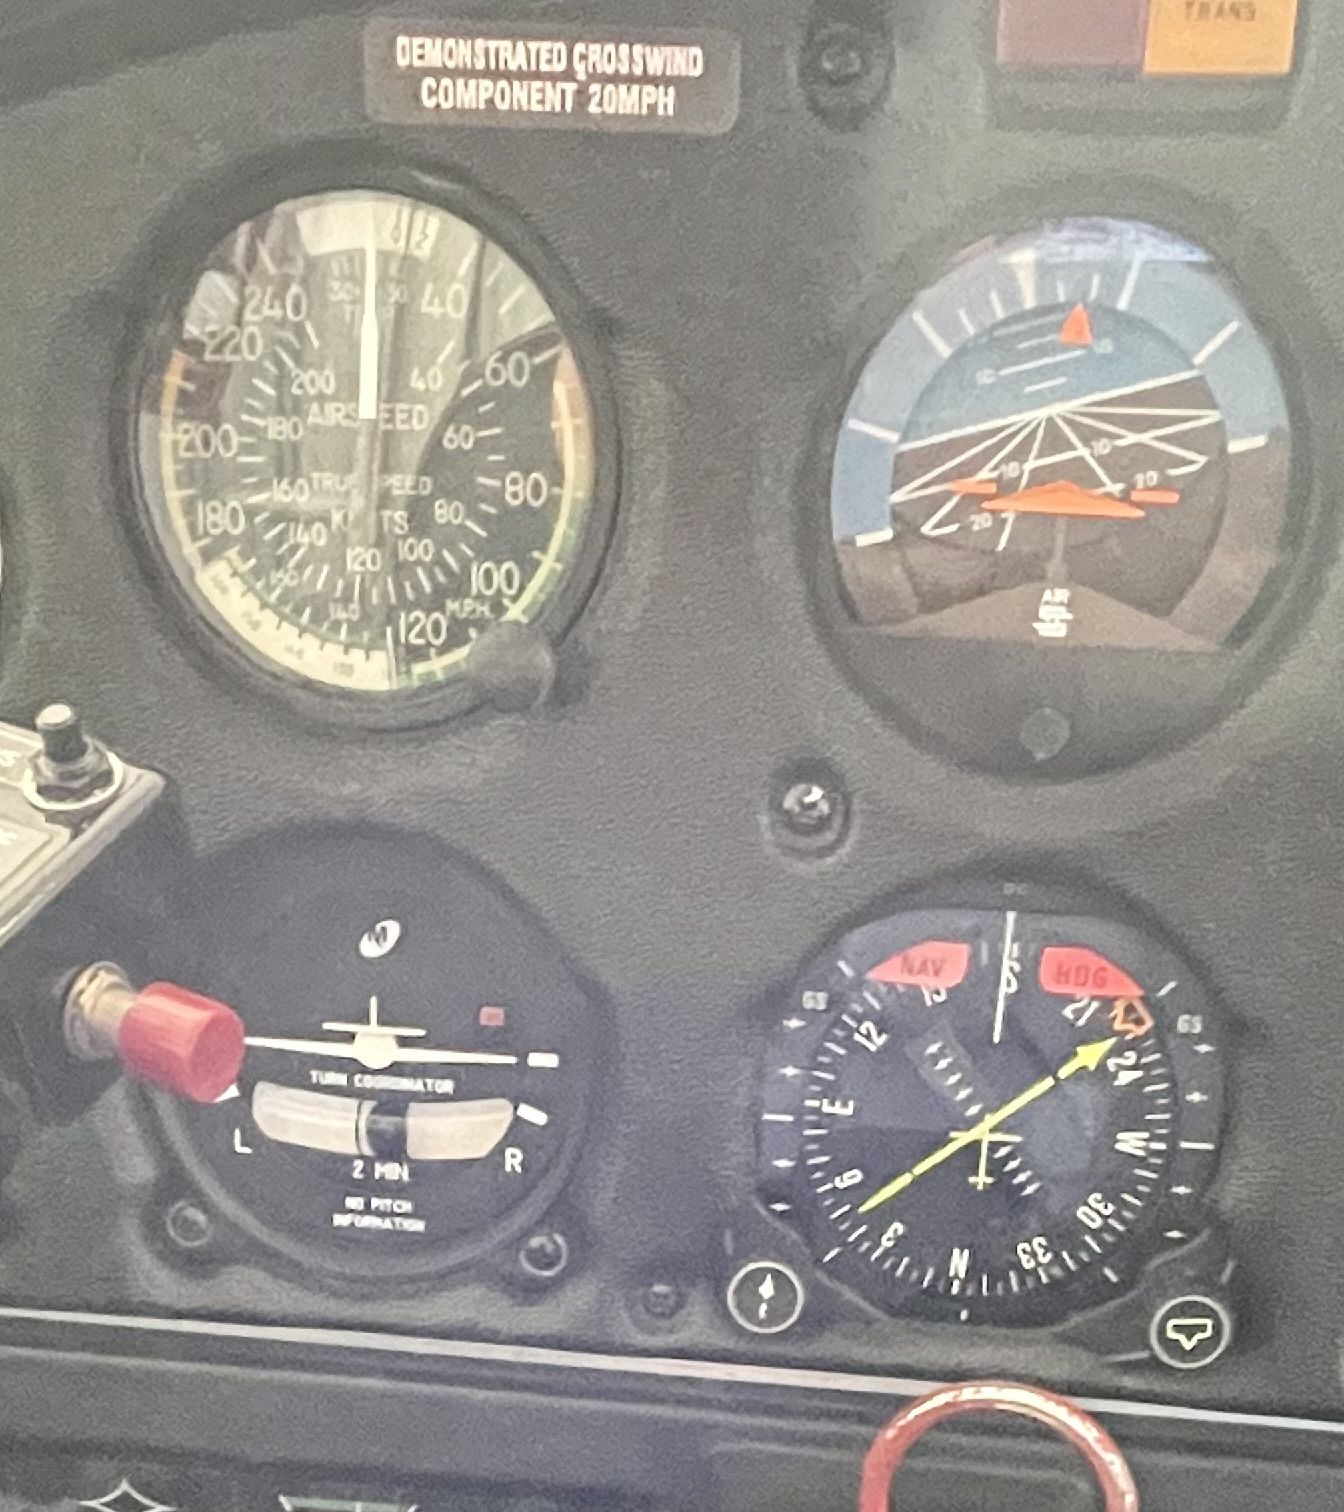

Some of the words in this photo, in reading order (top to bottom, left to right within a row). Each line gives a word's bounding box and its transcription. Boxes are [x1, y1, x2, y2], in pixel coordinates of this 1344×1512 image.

[395, 35, 570, 75] DEMONSTRATED
[572, 42, 704, 80] CROSSWIND
[420, 75, 576, 114] COMPONENT
[587, 81, 676, 117] 20MPH
[243, 283, 307, 321] 240
[421, 282, 464, 319] 40
[203, 327, 262, 361] 220
[410, 369, 442, 392] 40
[485, 350, 531, 387] 60
[290, 370, 336, 395] 200
[267, 417, 304, 440] 180
[306, 402, 429, 430] AIRSEED
[178, 424, 238, 459] 200
[442, 425, 476, 450] 60
[273, 479, 309, 503] 160
[504, 472, 548, 505] 80
[1134, 471, 1158, 489] 20
[197, 499, 247, 538] 180
[434, 499, 464, 525] 80
[968, 513, 993, 531] 20
[288, 521, 327, 547] 140
[346, 548, 381, 572] 120
[398, 538, 434, 562] 100
[470, 560, 519, 596] 100
[399, 609, 447, 645] 120
[899, 952, 946, 977] NAV
[1056, 961, 1109, 989] HDG
[853, 1020, 888, 1052] 12
[310, 1069, 348, 1086] TURN
[1107, 1050, 1144, 1087] 24
[821, 1098, 854, 1116] E
[234, 1128, 253, 1154] L
[1115, 1131, 1151, 1156] W
[352, 1160, 365, 1180] 2
[374, 1161, 411, 1183] MIN
[504, 1146, 524, 1173] R
[370, 1196, 413, 1214] PITCH
[1076, 1190, 1115, 1231] 30
[949, 1247, 971, 1279] N
[1015, 1235, 1053, 1270] 33
